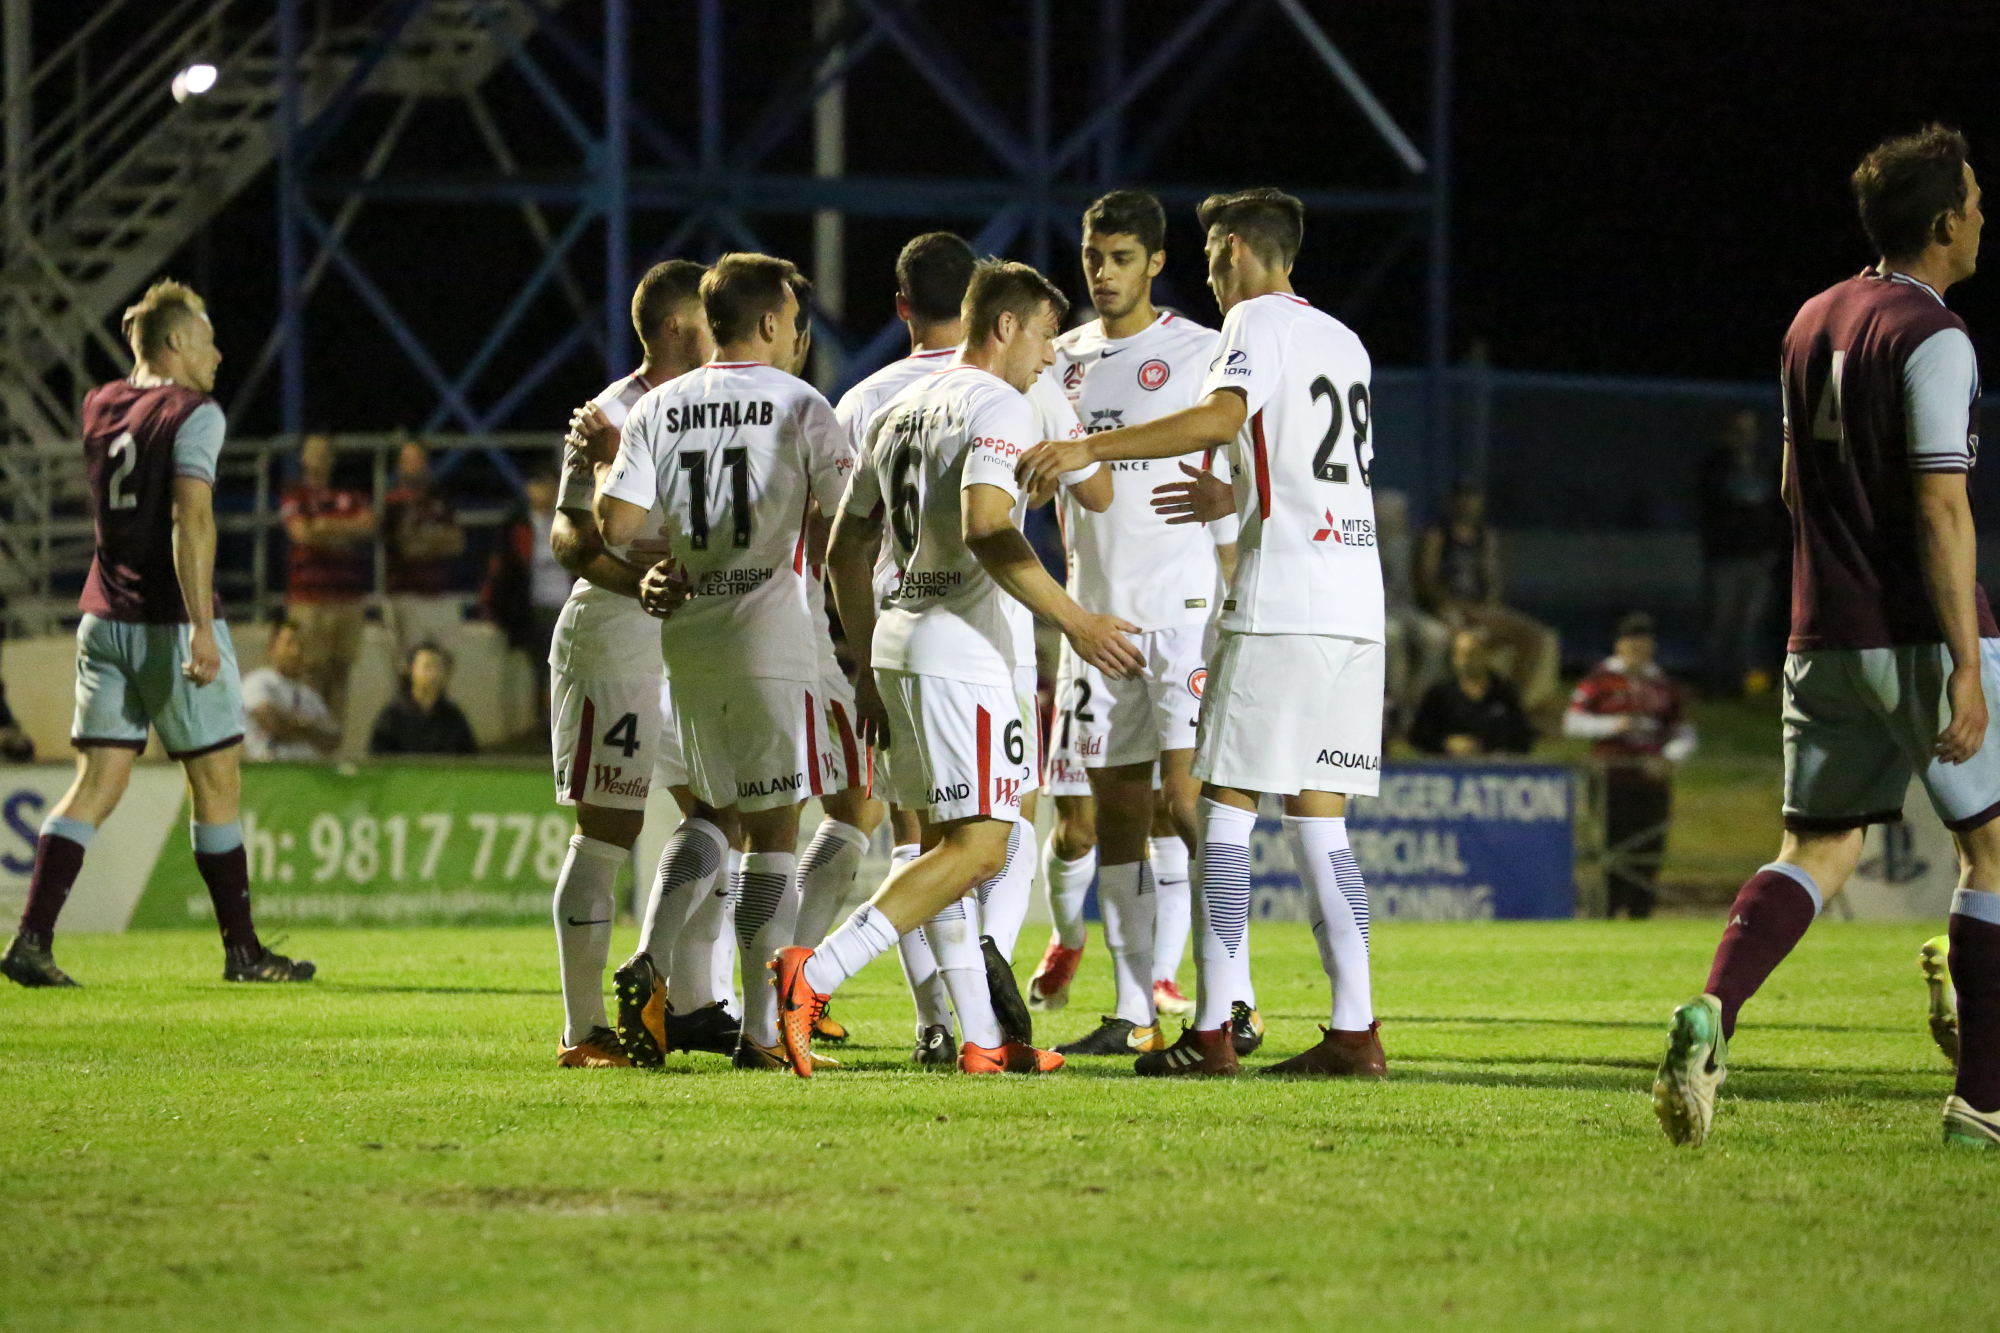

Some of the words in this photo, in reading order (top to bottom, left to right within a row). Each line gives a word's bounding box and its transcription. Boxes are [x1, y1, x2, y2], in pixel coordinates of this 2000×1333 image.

[666, 400, 774, 434] SANTALAB
[1309, 374, 1371, 489] 28
[971, 436, 1022, 458] peppe
[108, 431, 137, 510] 2
[678, 446, 751, 551] 11
[891, 445, 922, 553] 6
[904, 571, 962, 585] SUBISHI
[603, 712, 640, 758] 4
[1003, 719, 1024, 765] 6
[1316, 748, 1381, 771] AQUALA
[737, 773, 803, 797] UALAND
[926, 783, 970, 805] ALAND
[309, 812, 454, 883] 9817
[467, 812, 566, 881] 778
